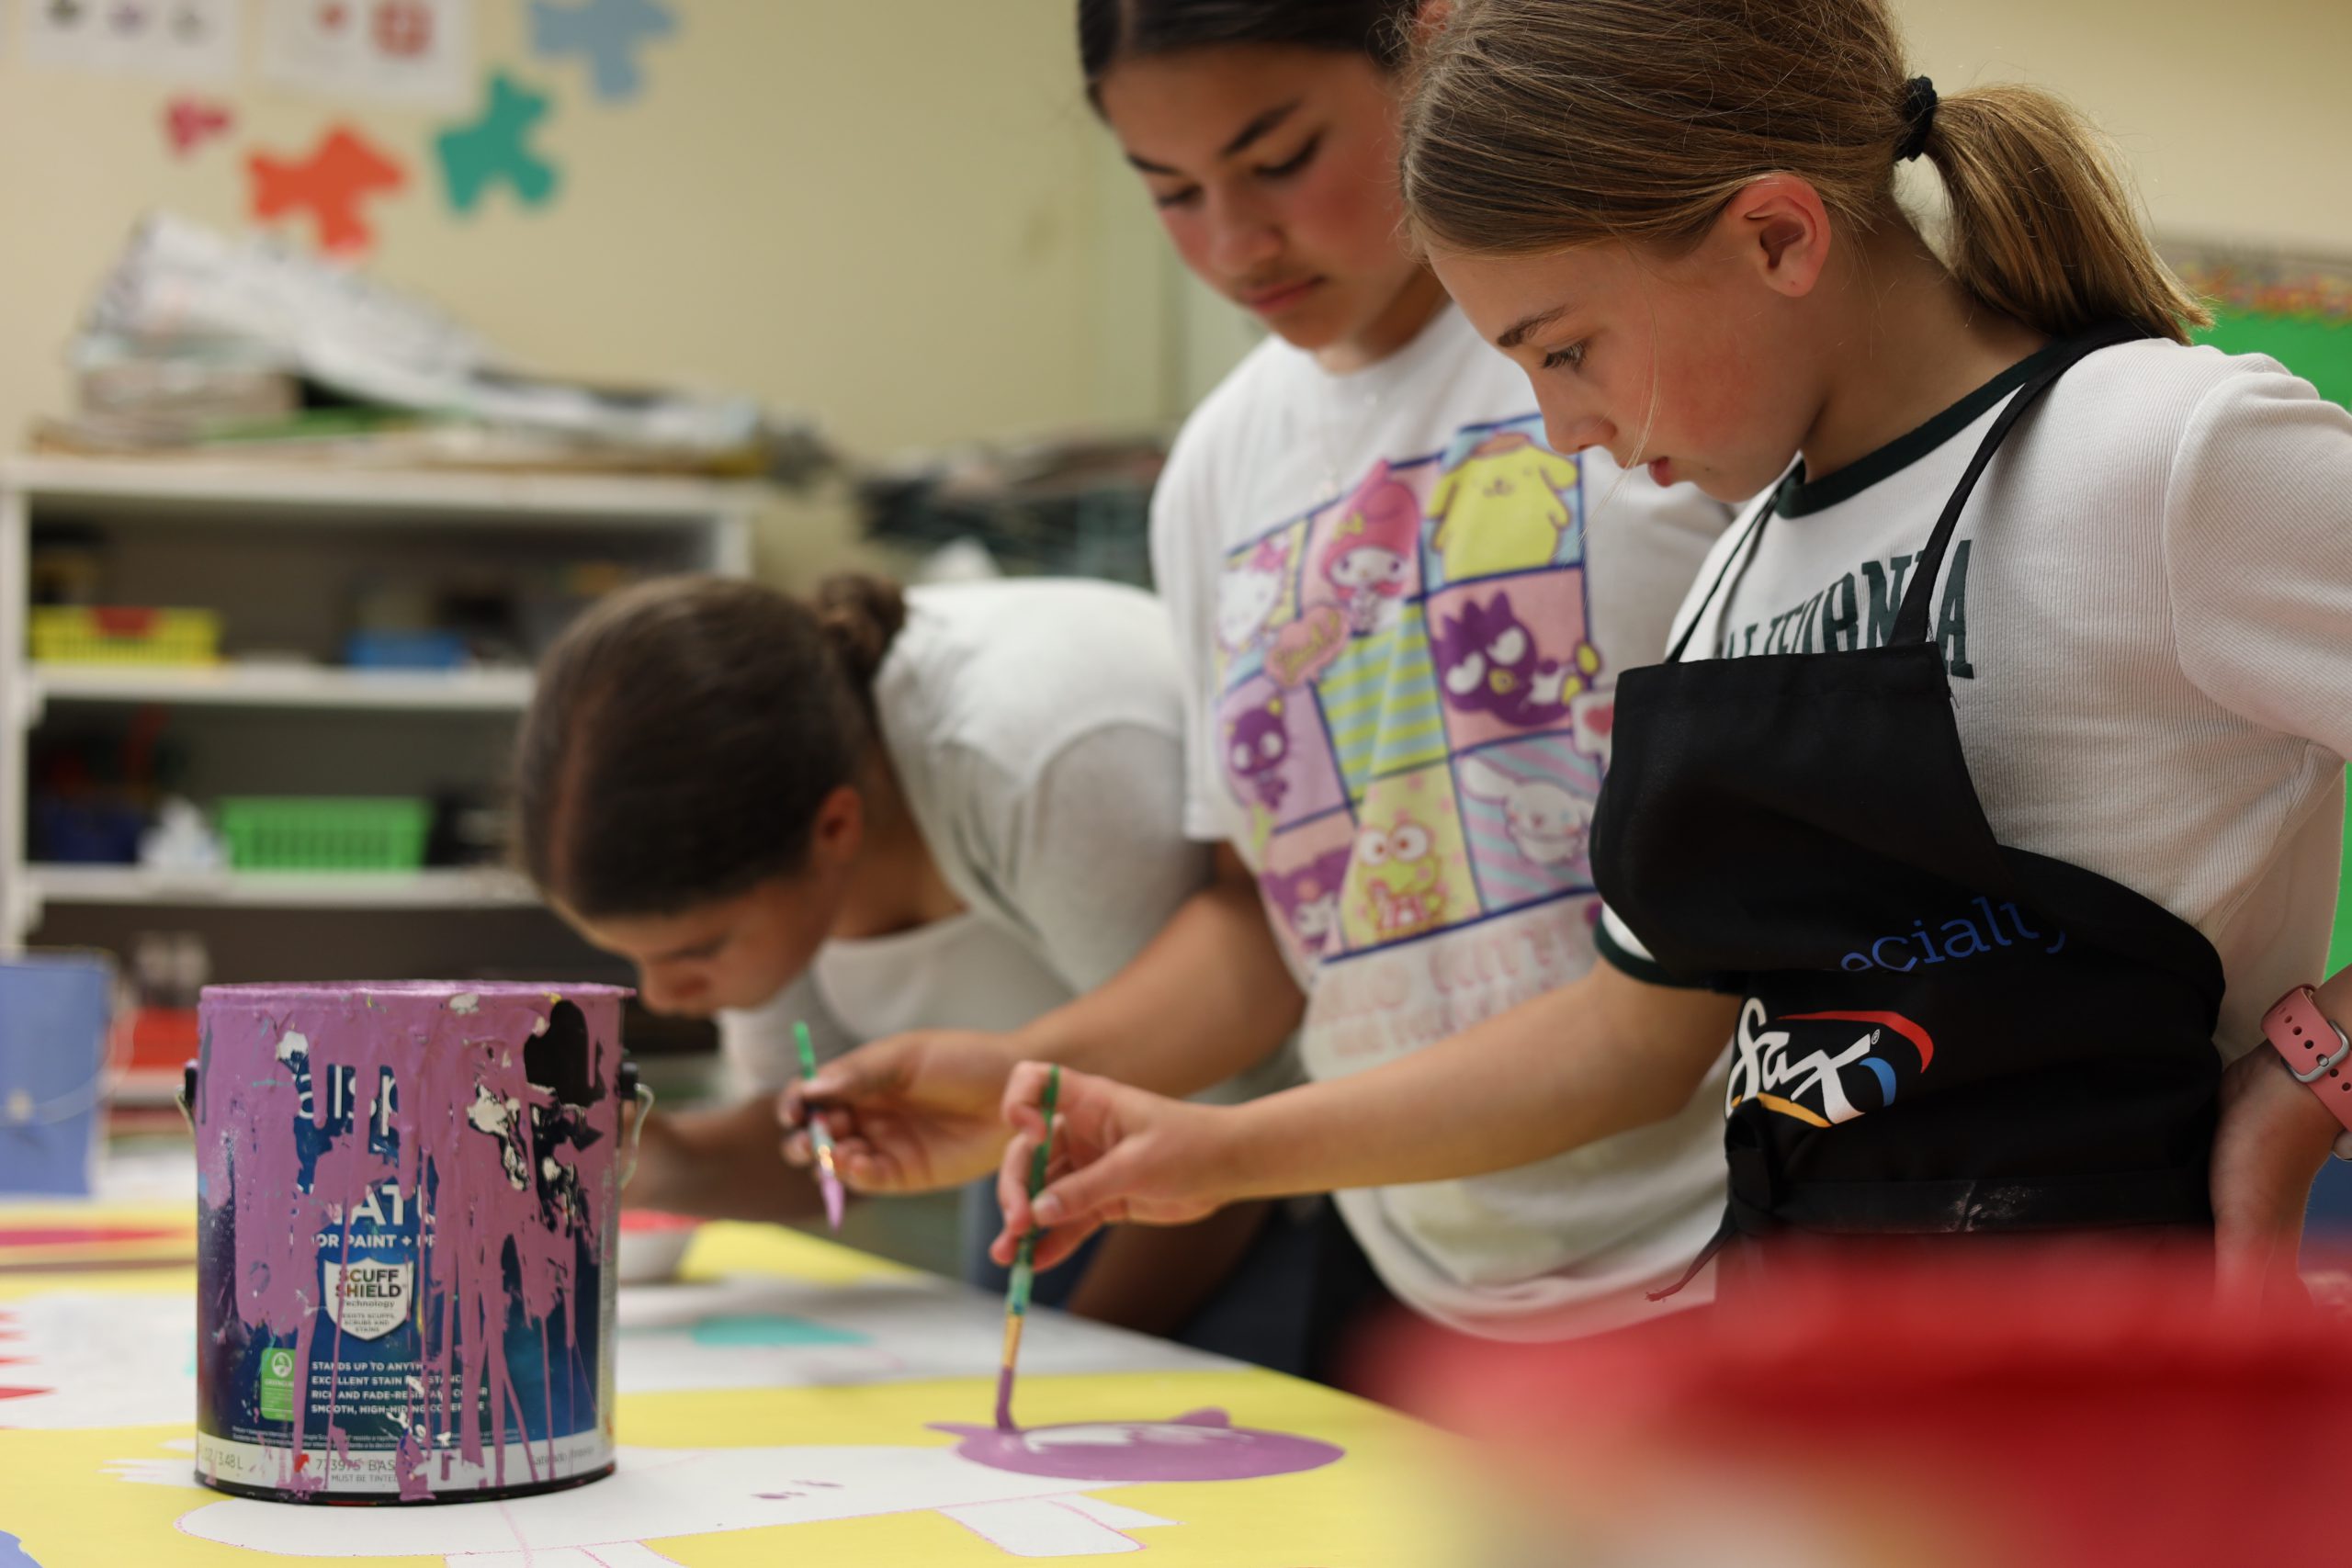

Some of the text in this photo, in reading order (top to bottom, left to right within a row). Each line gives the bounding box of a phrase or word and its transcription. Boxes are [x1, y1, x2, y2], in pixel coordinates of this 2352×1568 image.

[1724, 998, 1872, 1124] Sax
[345, 1299, 396, 1308] echnology
[353, 1361, 368, 1371] UP
[371, 1361, 385, 1371] TO
[371, 1375, 401, 1385] STAIN
[337, 1390, 361, 1401] AND
[368, 1458, 396, 1472] BAS
